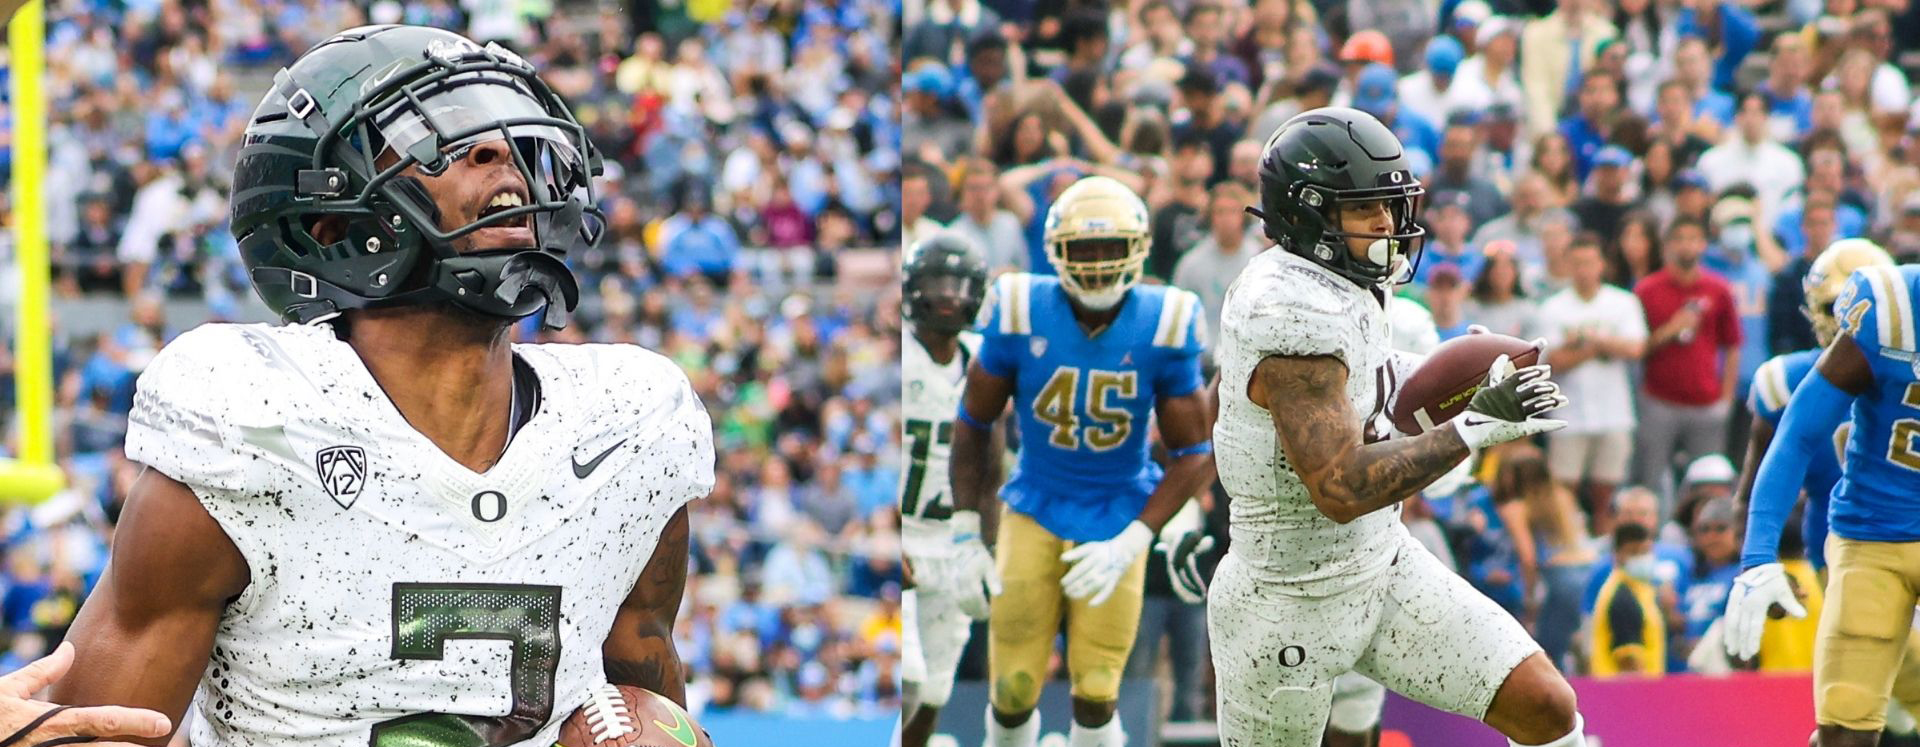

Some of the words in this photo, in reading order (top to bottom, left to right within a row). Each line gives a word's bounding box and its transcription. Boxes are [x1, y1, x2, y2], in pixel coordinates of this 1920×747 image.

[1033, 366, 1137, 450] 45
[319, 449, 363, 485] PAC
[332, 473, 357, 496] 12
[471, 490, 508, 523] O
[1278, 645, 1306, 668] O
